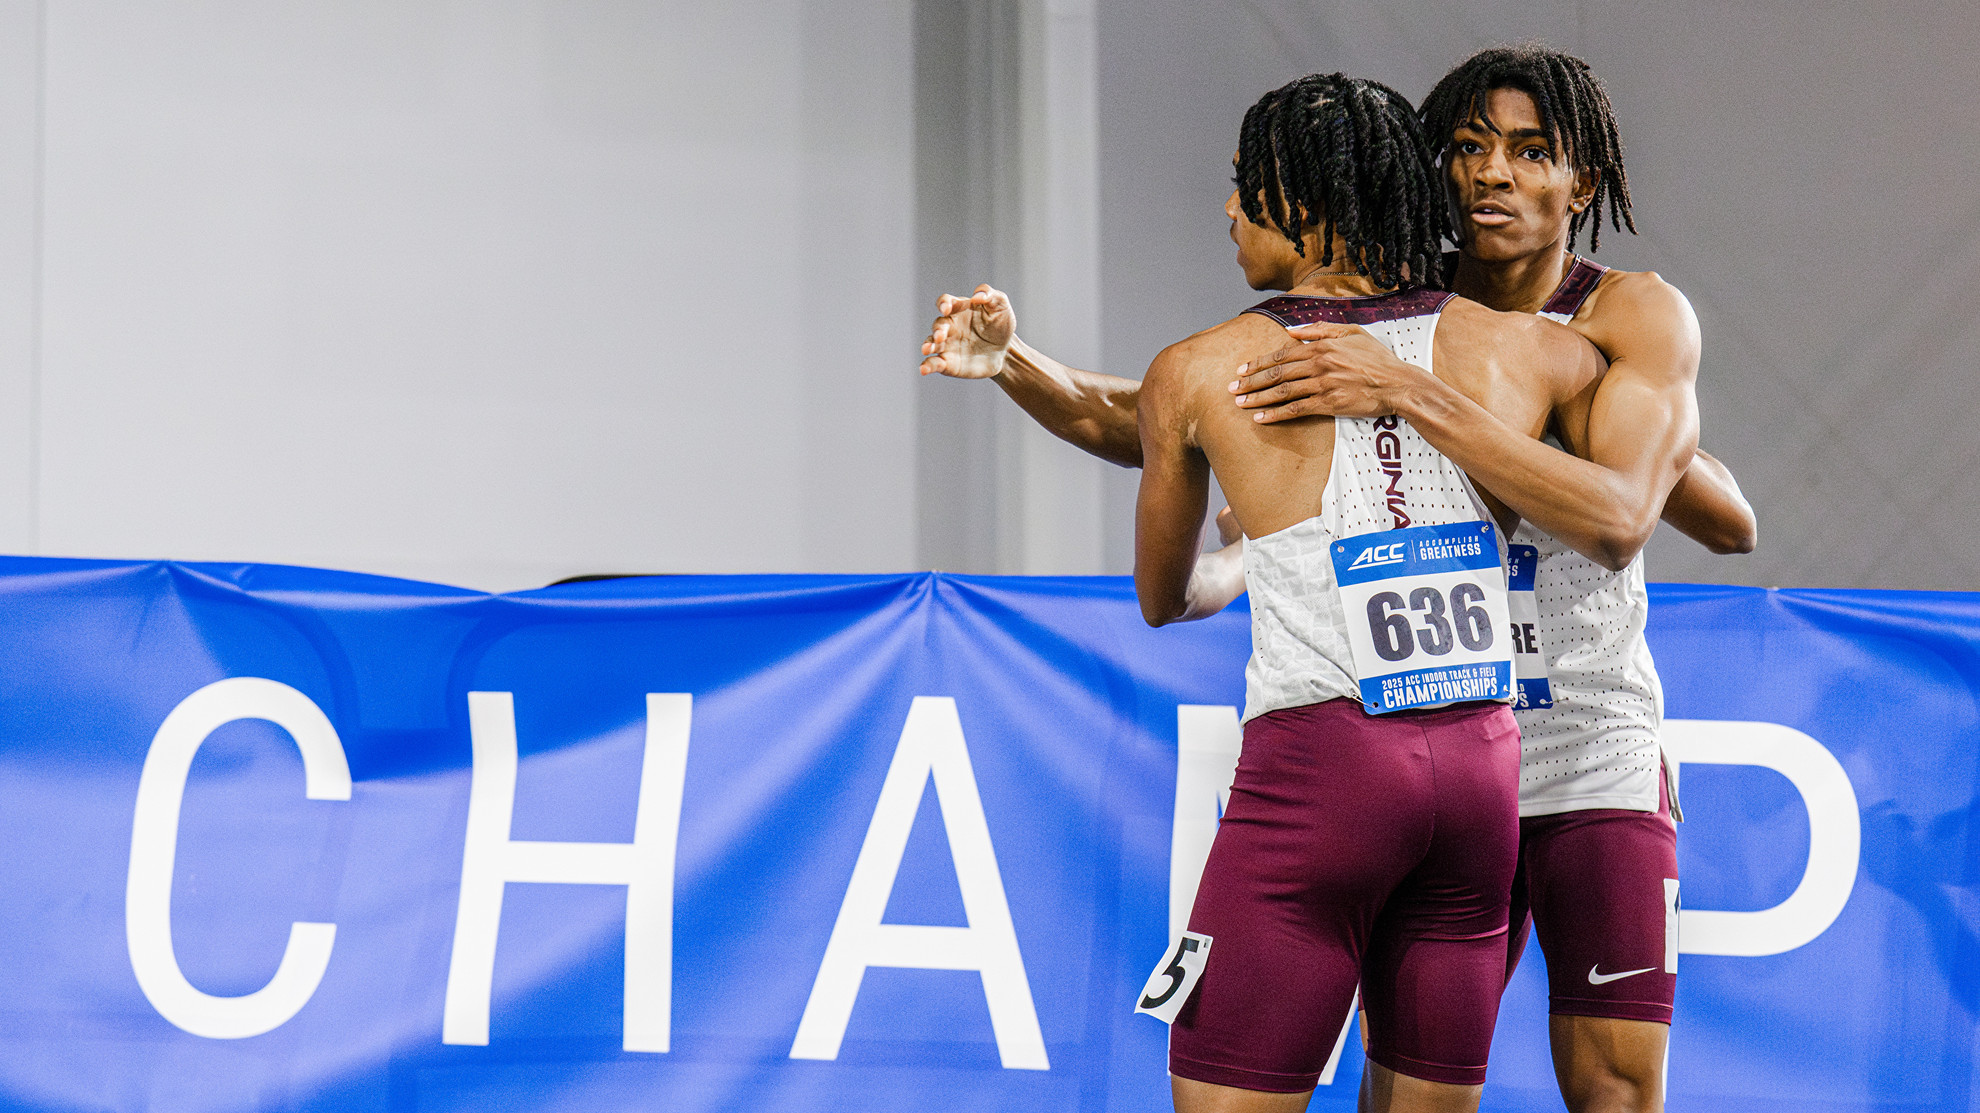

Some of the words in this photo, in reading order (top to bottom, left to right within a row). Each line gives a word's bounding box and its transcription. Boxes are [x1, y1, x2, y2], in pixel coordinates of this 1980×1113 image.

[1351, 542, 1405, 566] ACC
[1419, 535, 1479, 548] ACCOMPLISH
[1420, 543, 1482, 561] GREATNESS
[1366, 582, 1494, 662] 636
[1382, 677, 1403, 691] 2025
[1405, 674, 1420, 686] ACC
[1422, 671, 1447, 684] INDOOR
[1449, 668, 1471, 681] TRACK
[1472, 668, 1478, 678] &
[1479, 666, 1496, 678] FIELD
[1383, 677, 1498, 709] CHAMPIONSHIPS
[1139, 936, 1200, 1010] 5
